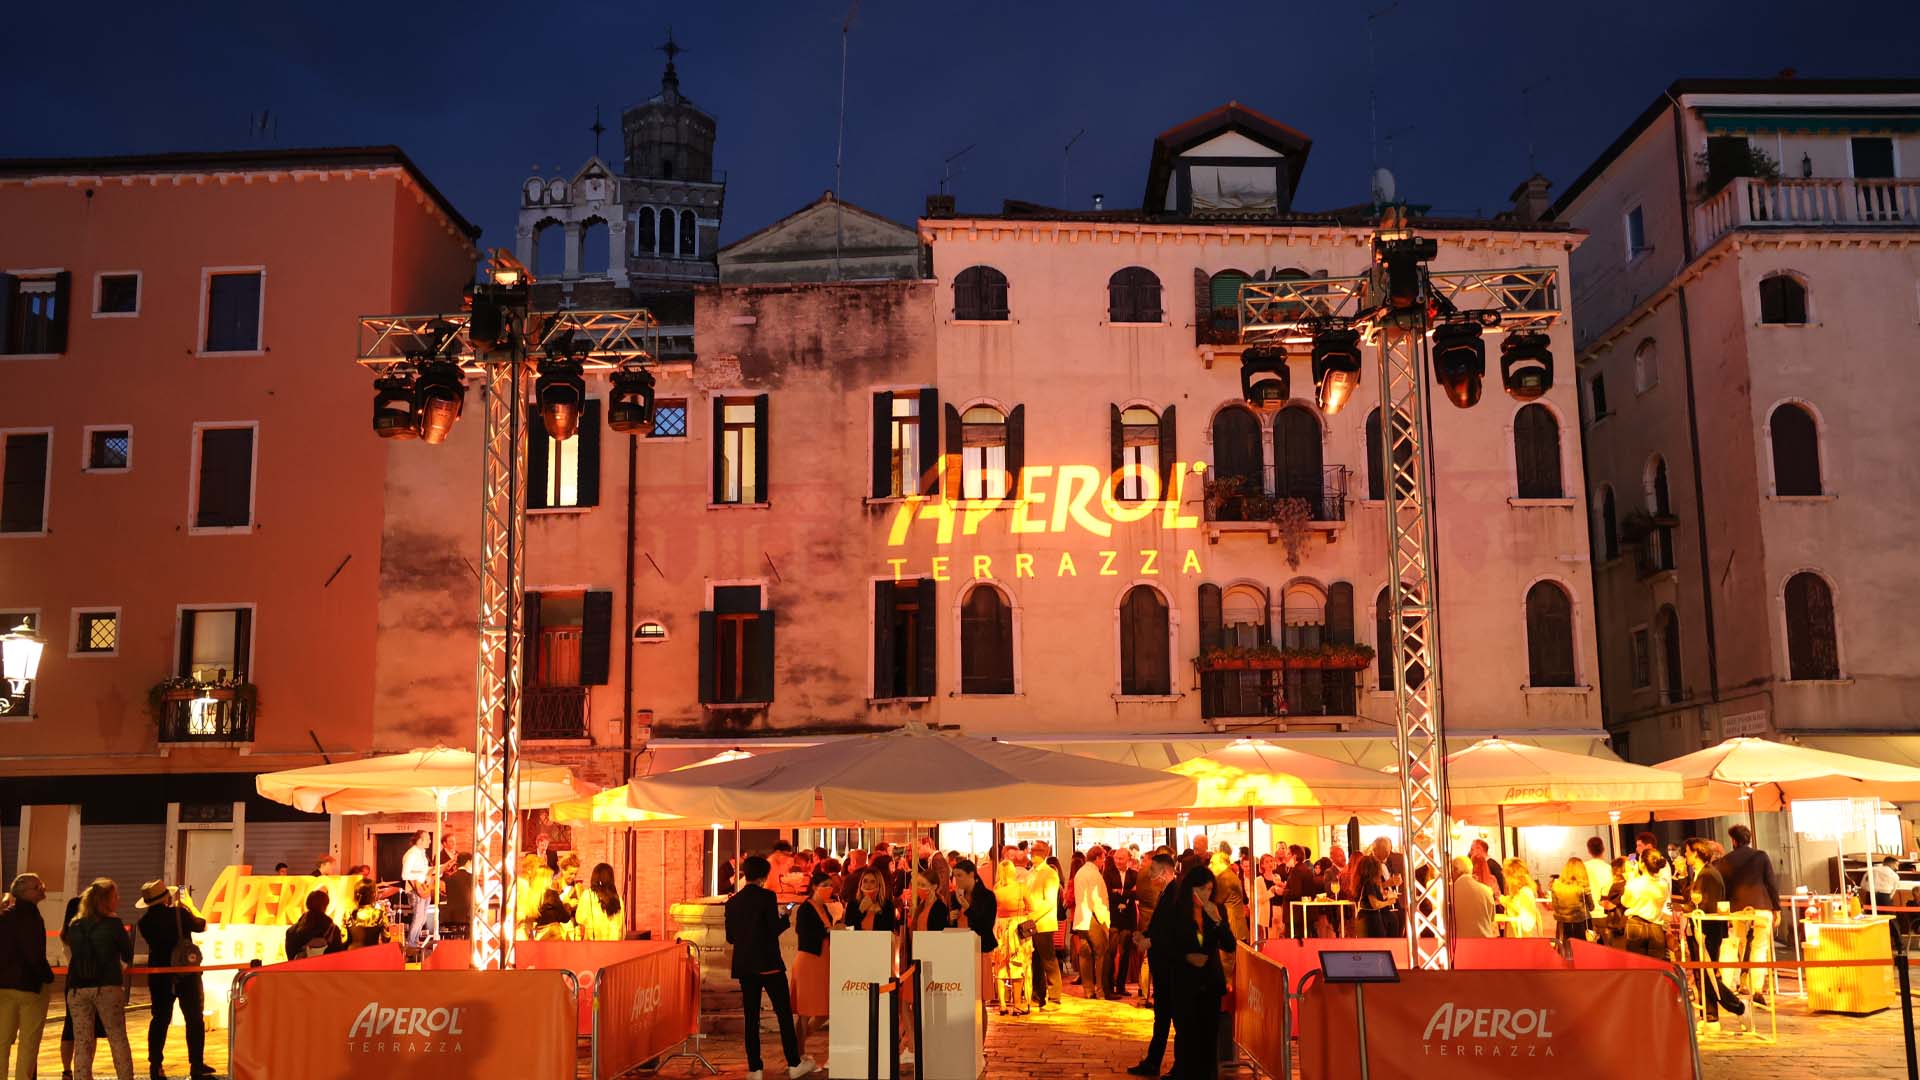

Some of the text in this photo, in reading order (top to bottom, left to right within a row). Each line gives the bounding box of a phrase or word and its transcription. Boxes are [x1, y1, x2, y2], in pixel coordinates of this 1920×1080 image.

[888, 454, 1199, 546] APEROL
[887, 549, 1202, 582] TERRAZZA
[842, 980, 870, 992] APER
[926, 980, 963, 992] APEROL
[348, 1001, 464, 1038] APEROL
[1423, 1002, 1553, 1040] APEROL
[348, 1042, 462, 1053] TERRAZZA
[1423, 1045, 1554, 1056] TERRAZZA
